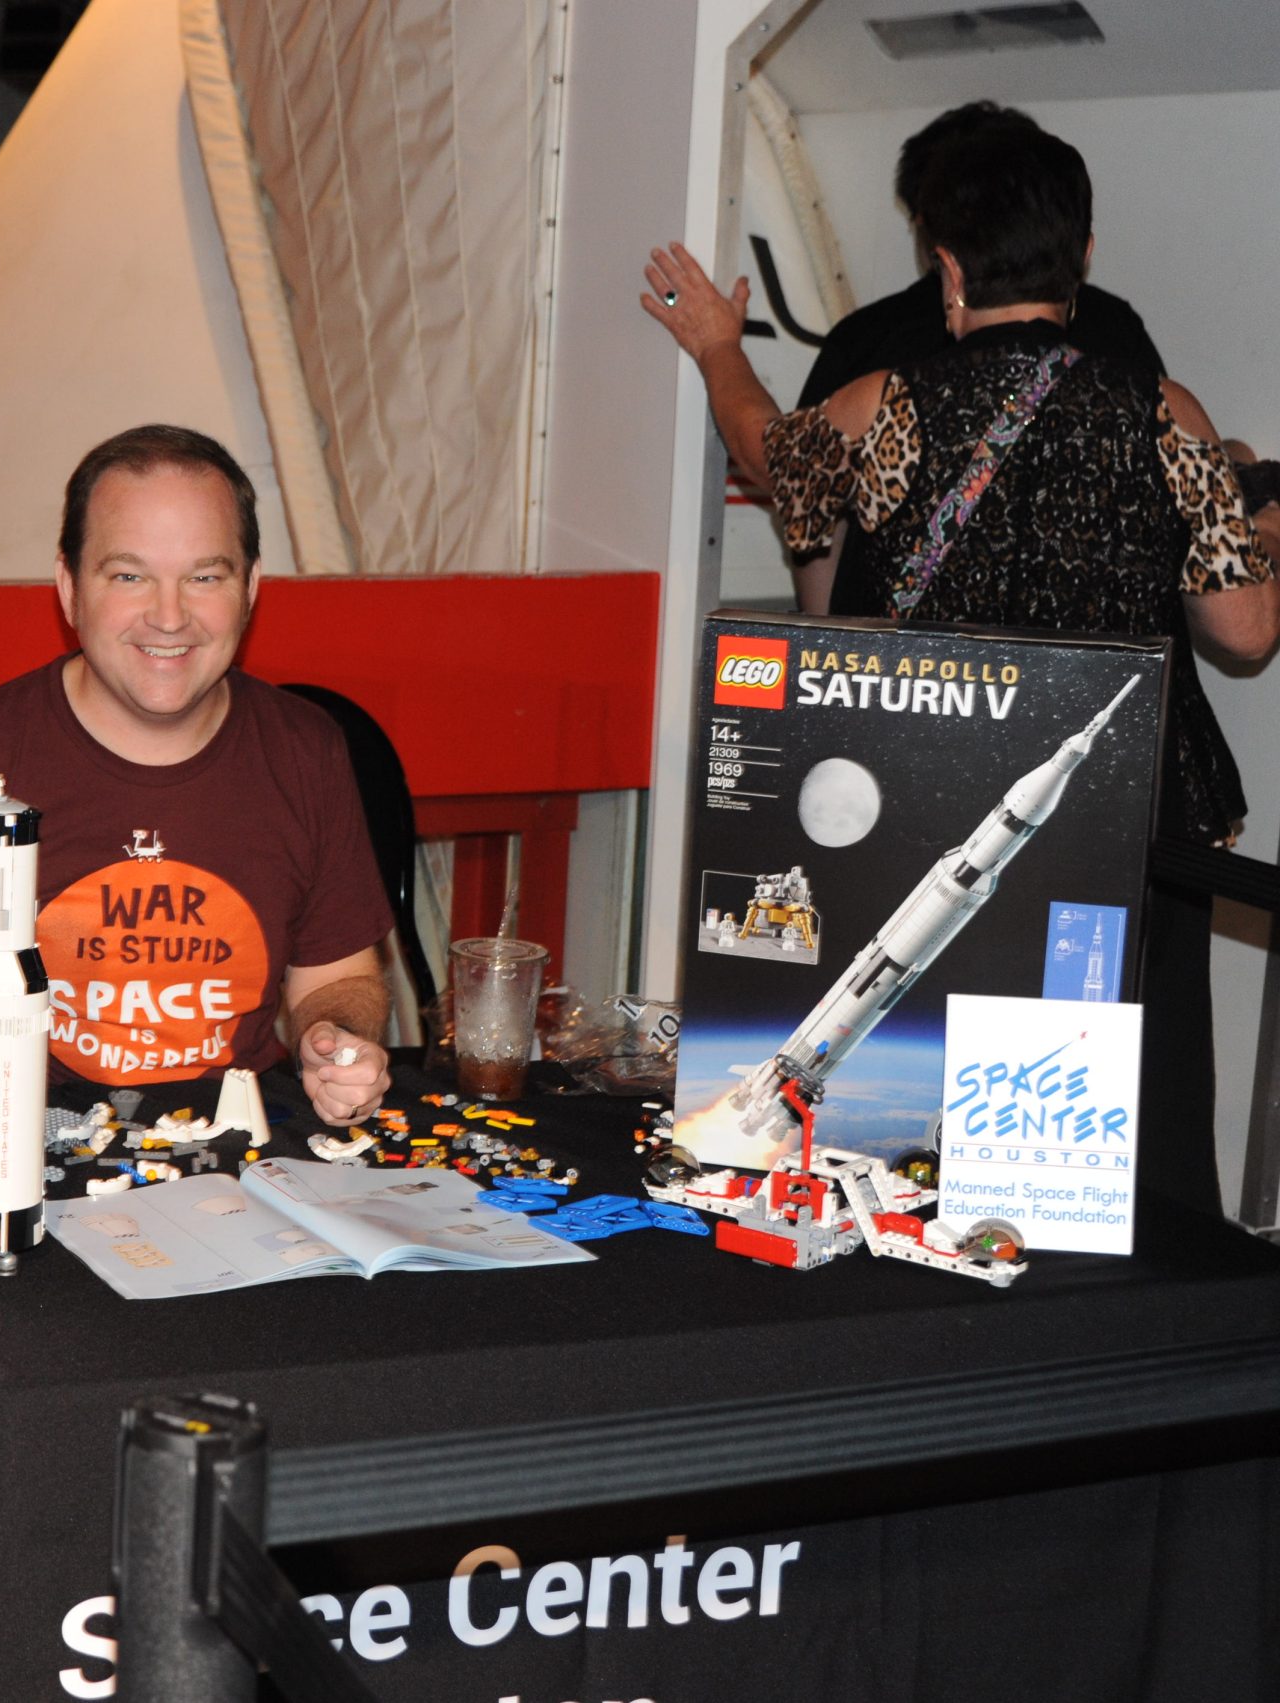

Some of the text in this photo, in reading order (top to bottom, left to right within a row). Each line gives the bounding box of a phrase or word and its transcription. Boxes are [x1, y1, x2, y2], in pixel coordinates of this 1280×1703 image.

[720, 657, 781, 685] LEGO
[800, 650, 1019, 685] NASA APOLLO
[796, 669, 1019, 720] SATURN V
[710, 725, 742, 742] 14+
[708, 746, 740, 759] 21309
[708, 761, 743, 777] 1969
[101, 884, 206, 930] WAR
[76, 934, 233, 966] IS STUPID
[48, 979, 235, 1024] SPACE
[130, 1028, 157, 1044] IS
[947, 1060, 1089, 1112] SPACE
[964, 1101, 1128, 1144] CENTER
[950, 1145, 1129, 1169] HOUSTON
[944, 1178, 1129, 1208] Manned Space Flight
[944, 1199, 1127, 1225] Education Foundation
[448, 1535, 802, 1647] Center
